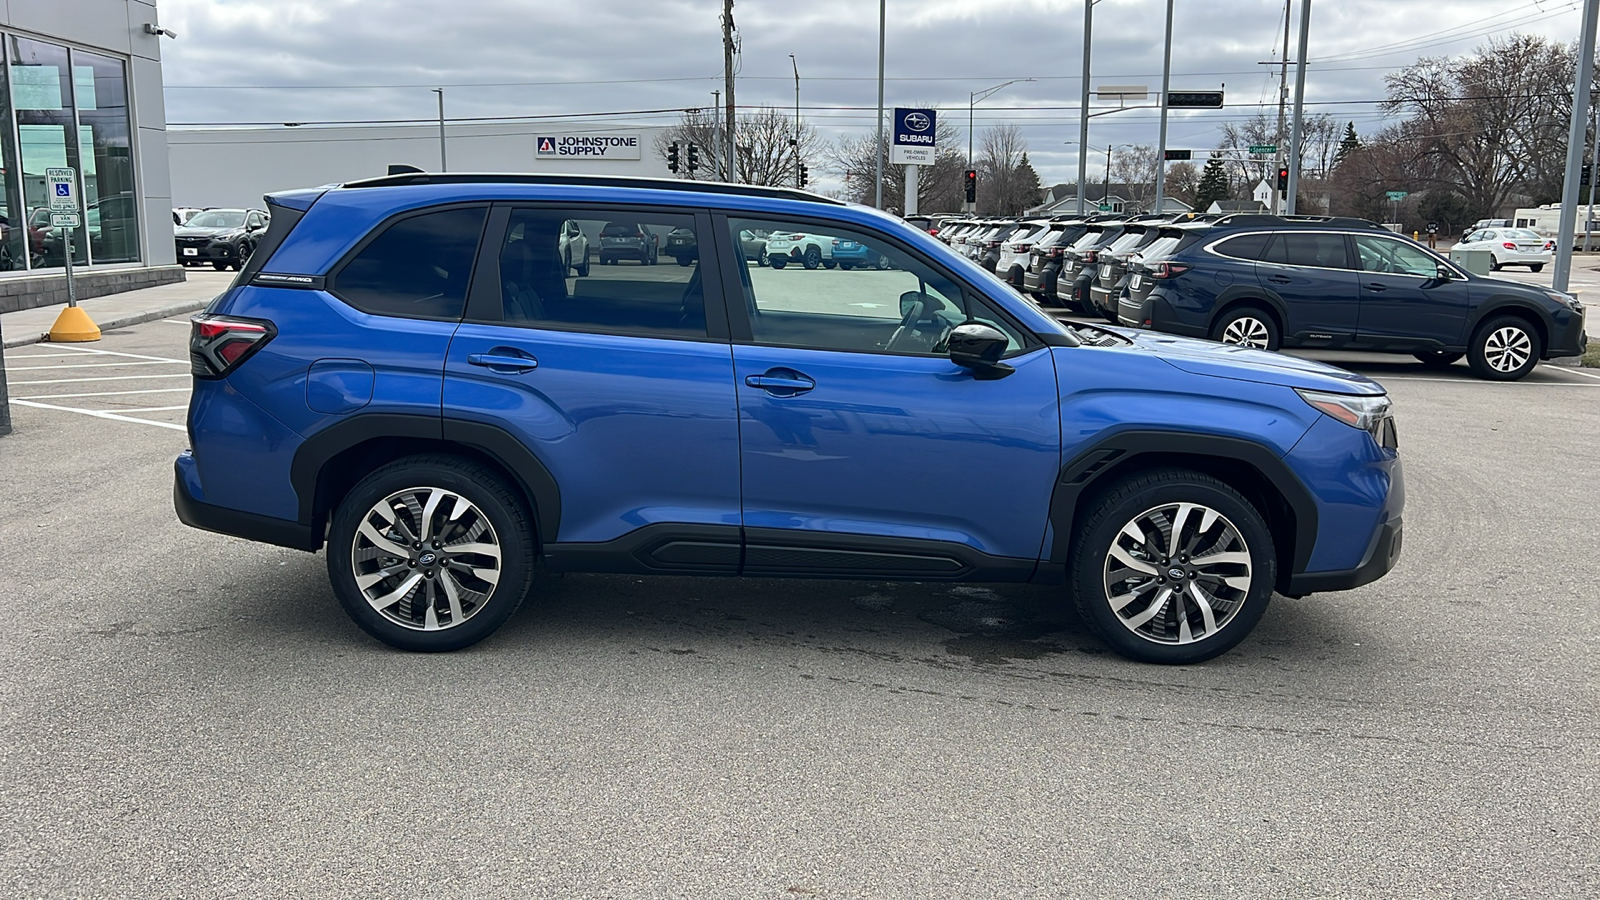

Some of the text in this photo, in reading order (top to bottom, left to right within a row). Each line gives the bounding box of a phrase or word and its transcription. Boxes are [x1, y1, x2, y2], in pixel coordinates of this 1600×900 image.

[558, 137, 637, 147] JOHNSTONE
[899, 134, 933, 143] SUBARU
[559, 146, 608, 155] SUPPLY
